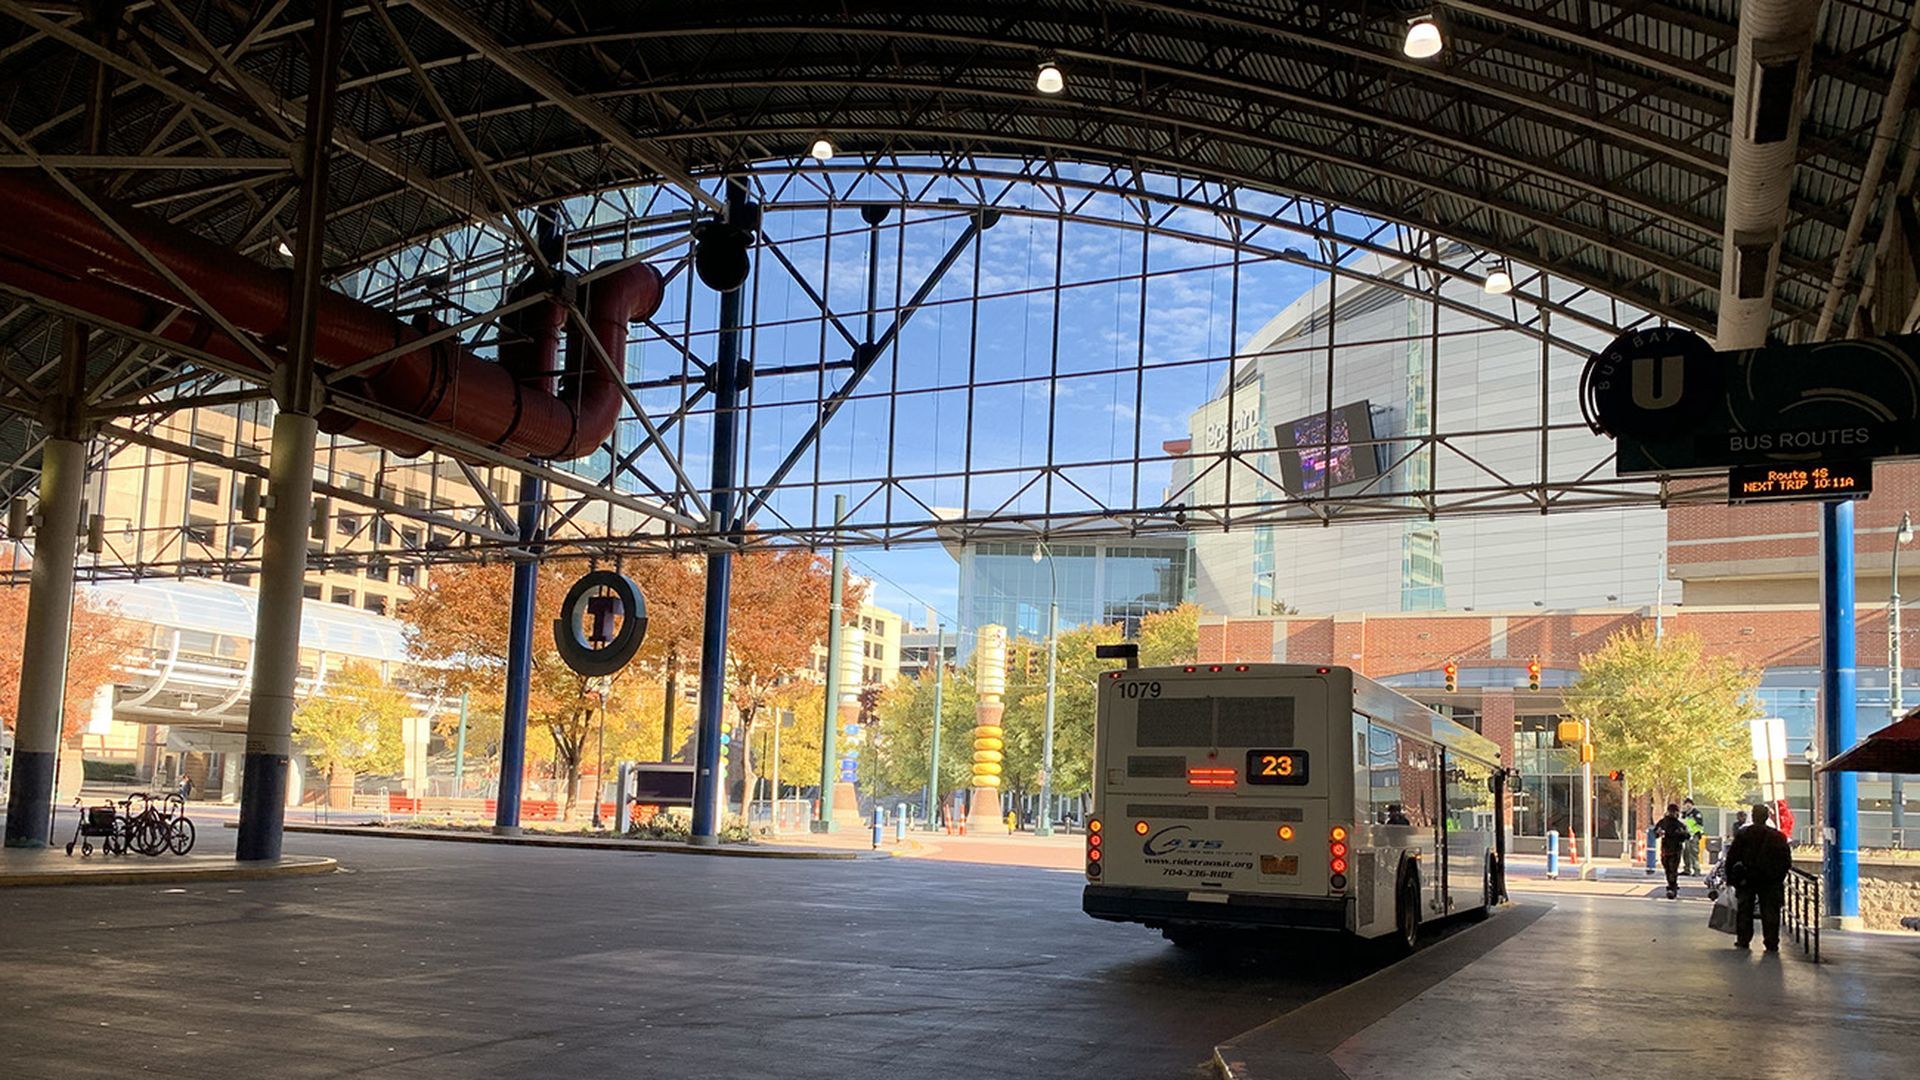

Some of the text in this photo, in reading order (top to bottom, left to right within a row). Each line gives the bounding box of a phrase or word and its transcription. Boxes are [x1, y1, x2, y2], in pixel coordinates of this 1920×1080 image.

[1597, 332, 1675, 390] BUS BAY
[1631, 355, 1685, 410] U
[1729, 427, 1870, 452] BUS ROUTES
[1743, 477, 1854, 492] NEXT TRIP 10:11A
[1768, 470, 1807, 481] Route
[1118, 682, 1161, 699] 1079
[1261, 755, 1293, 776] 23
[1144, 857, 1254, 870] www.ridetransit.org
